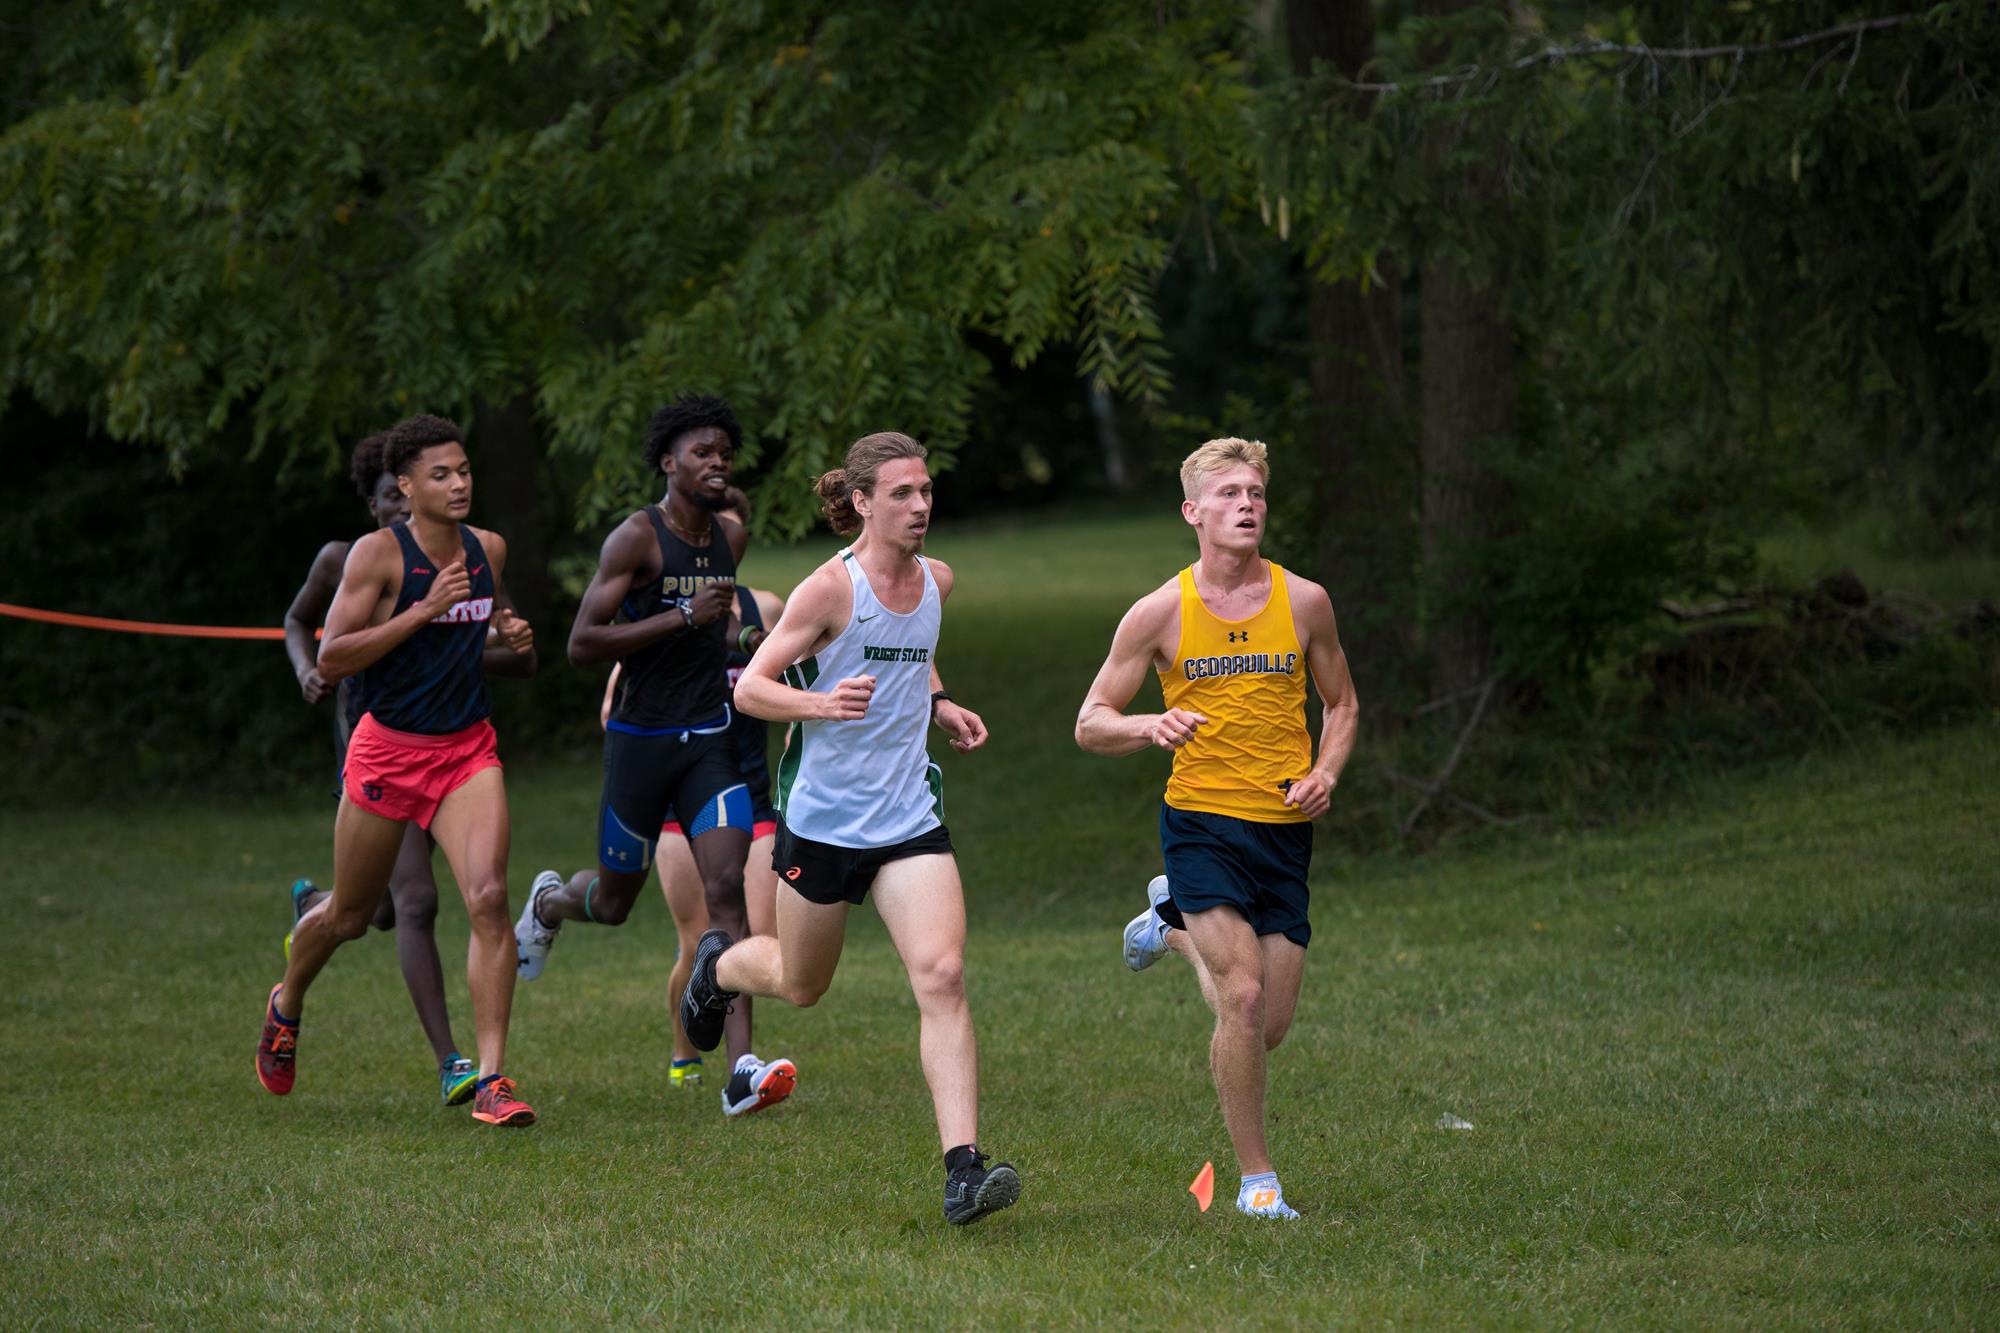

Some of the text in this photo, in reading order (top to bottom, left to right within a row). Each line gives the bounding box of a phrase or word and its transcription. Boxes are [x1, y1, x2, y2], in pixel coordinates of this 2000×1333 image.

[863, 645, 928, 663] WRIGHT STATE
[1183, 652, 1297, 681] CEDARVILLE
